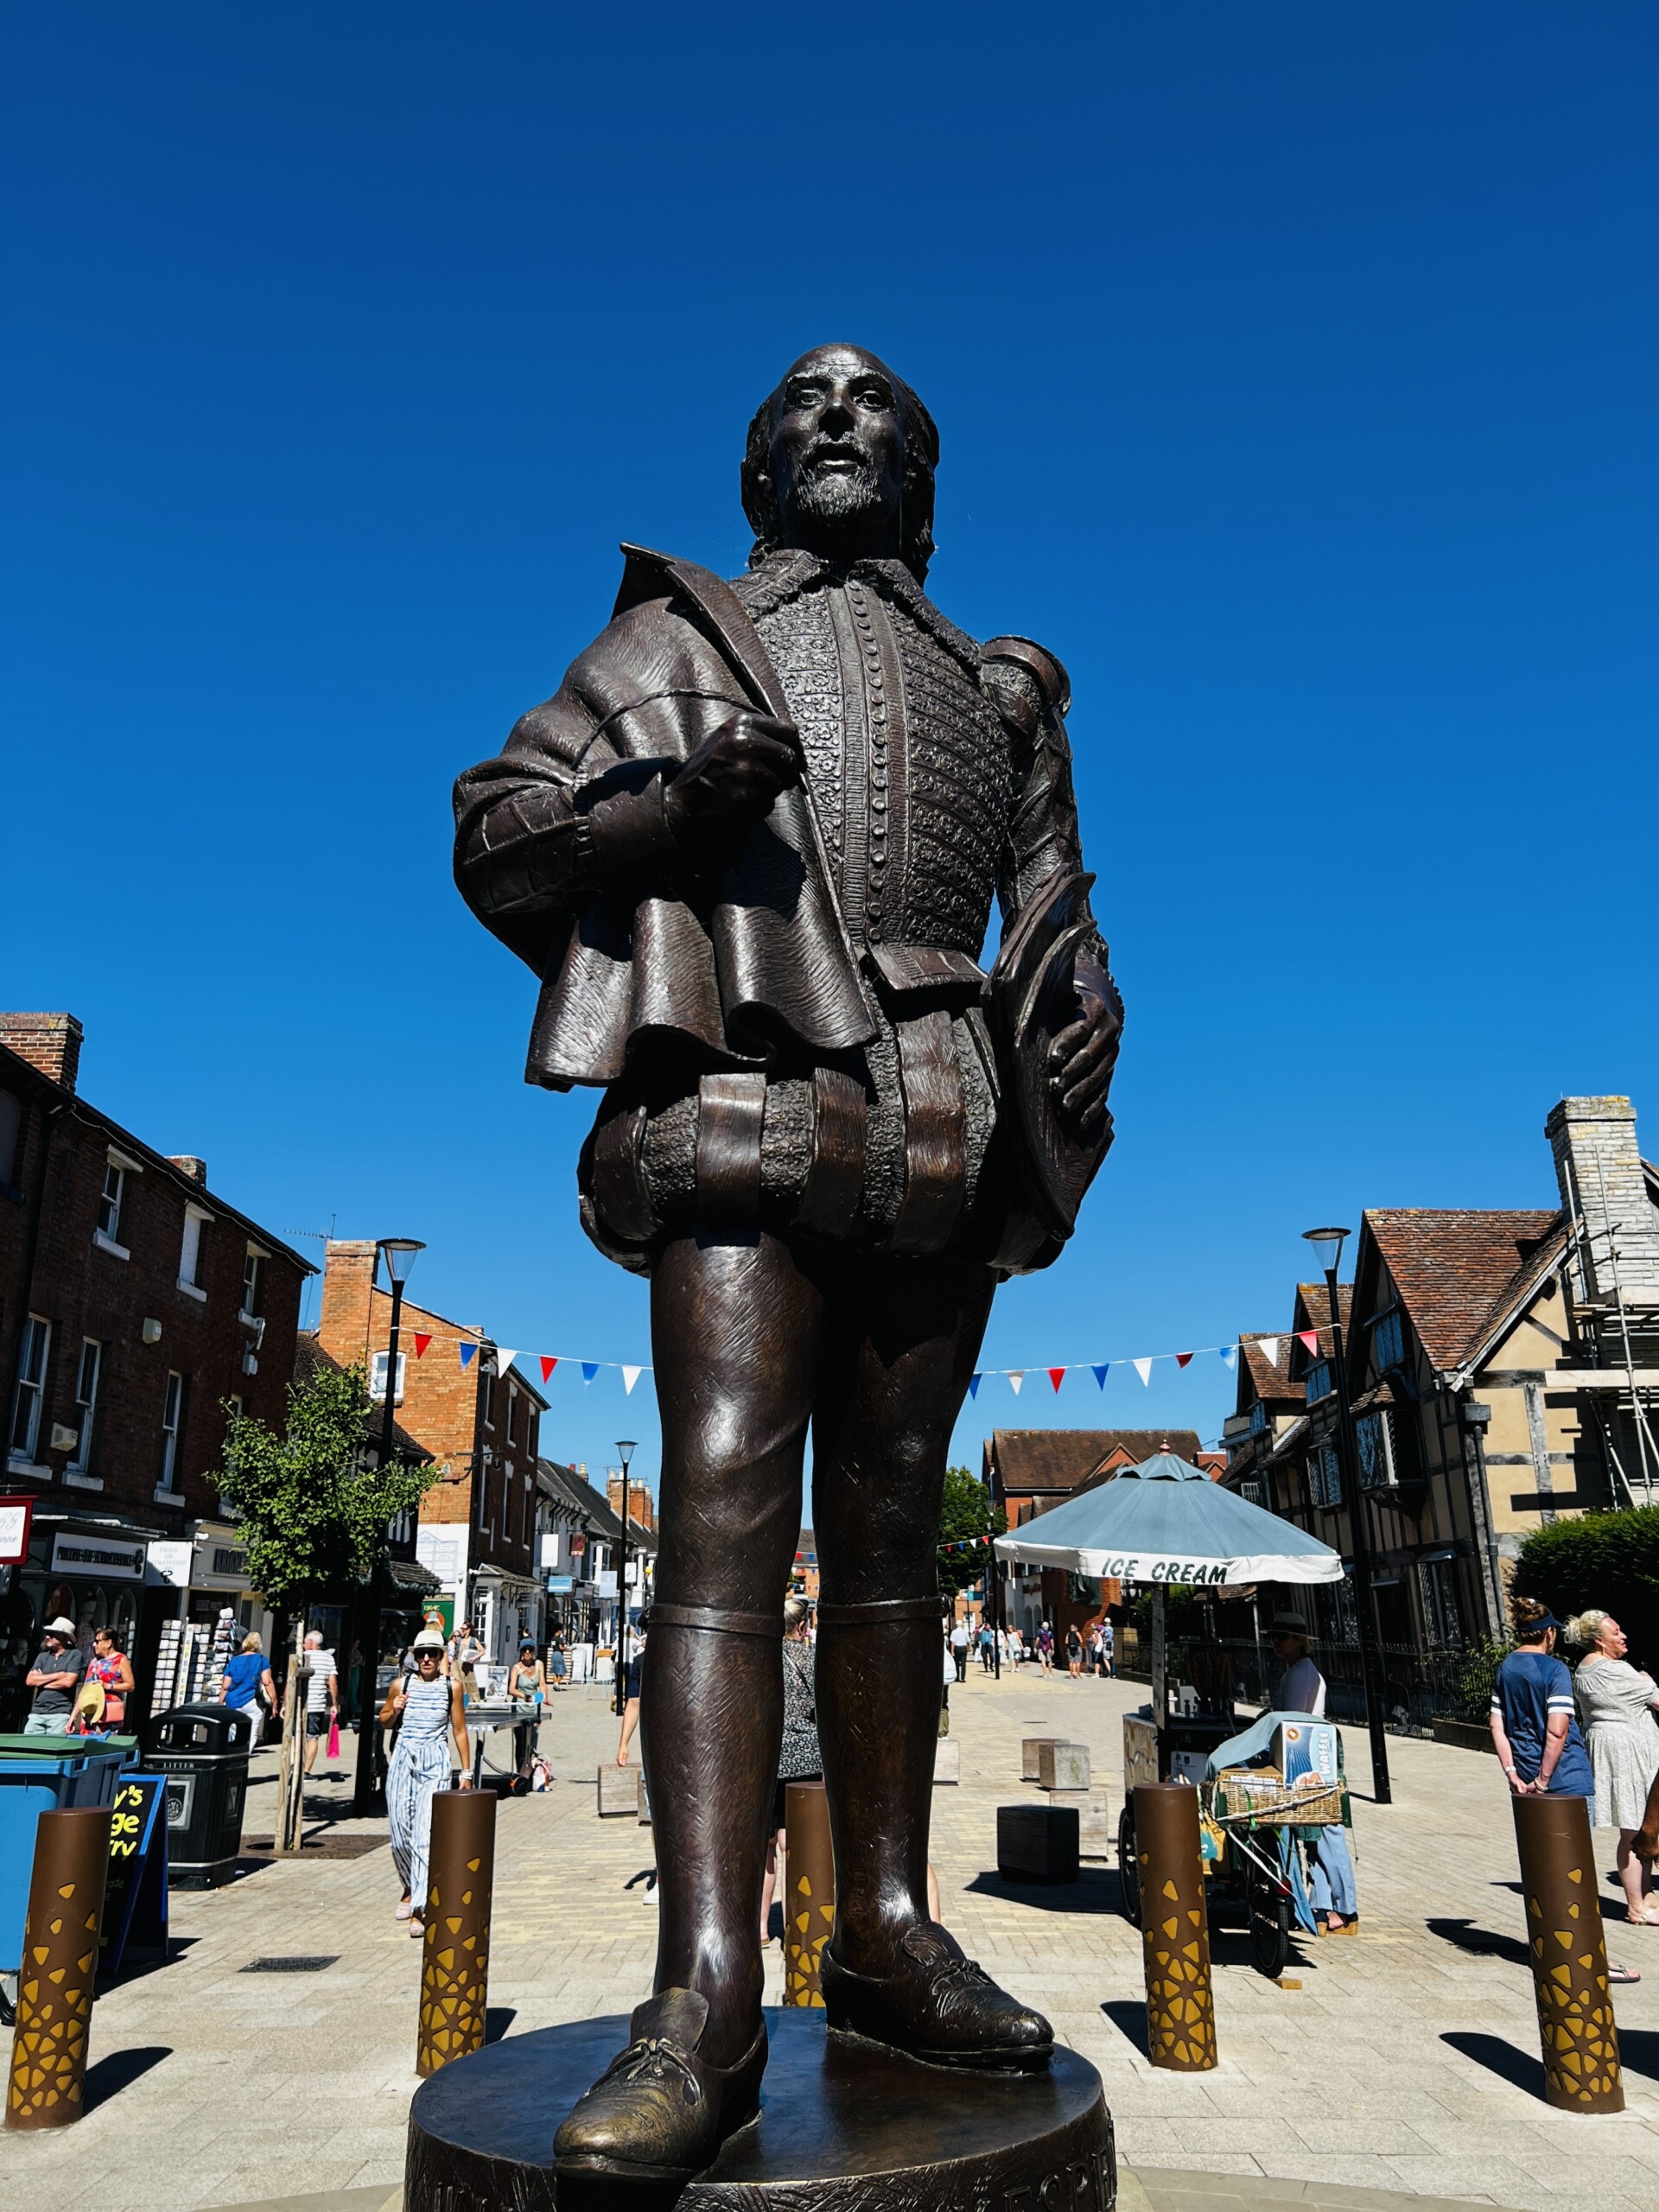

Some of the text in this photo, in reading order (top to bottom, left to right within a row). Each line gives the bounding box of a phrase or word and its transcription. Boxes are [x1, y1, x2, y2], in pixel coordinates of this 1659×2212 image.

[1102, 1557, 1228, 1585] ICE CREAM
[1318, 1732, 1332, 1775] WAFFLE
